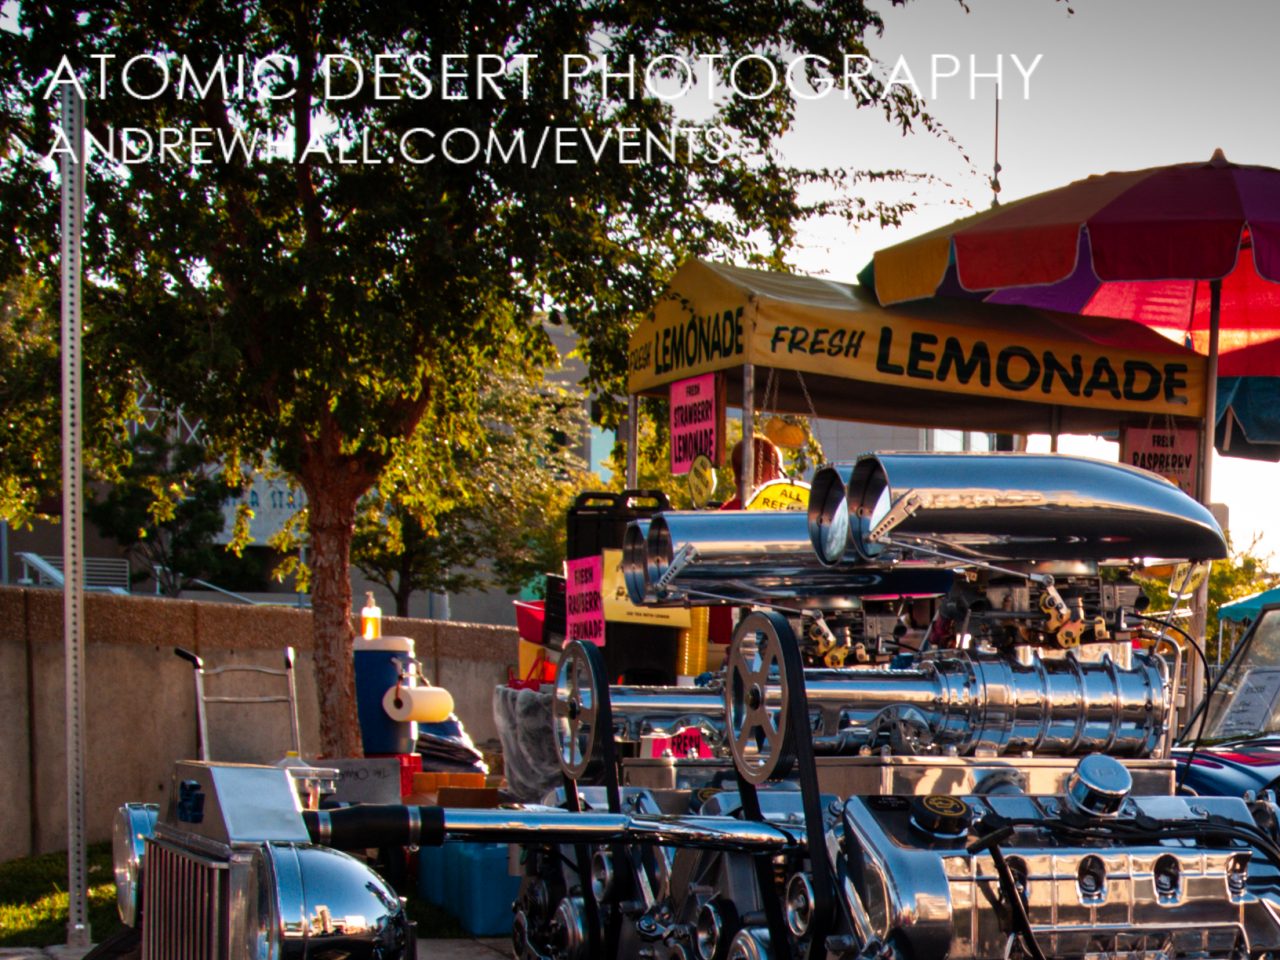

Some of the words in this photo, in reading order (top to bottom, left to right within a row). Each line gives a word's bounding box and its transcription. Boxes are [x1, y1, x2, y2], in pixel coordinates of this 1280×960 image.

[655, 307, 744, 375] LEMONADE
[771, 326, 865, 359] FRESH
[876, 326, 1189, 405] LEMONADE
[674, 400, 713, 428] STRAWBERRY
[780, 489, 802, 502] ALL
